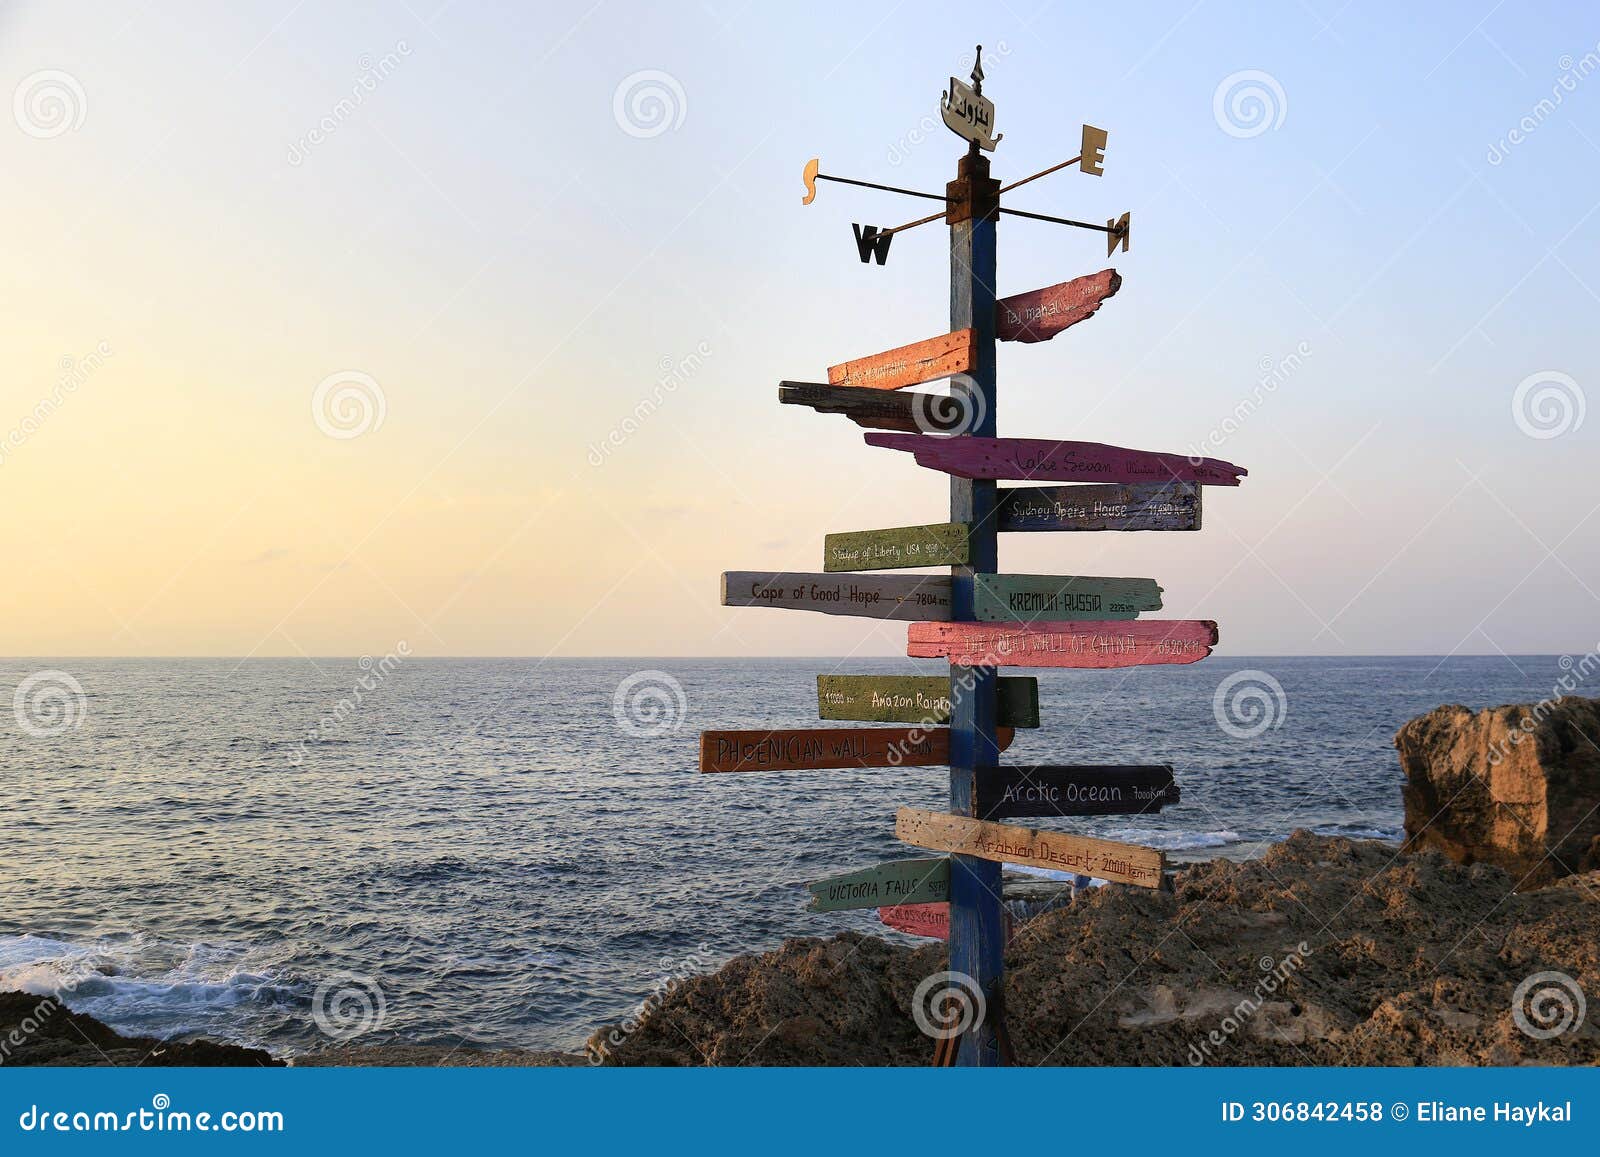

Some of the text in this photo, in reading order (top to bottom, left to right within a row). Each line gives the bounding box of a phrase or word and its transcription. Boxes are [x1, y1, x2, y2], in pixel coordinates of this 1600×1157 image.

[1080, 124, 1108, 176] E
[852, 223, 894, 265] W
[1012, 502, 1050, 523] Sydney
[1054, 502, 1086, 520] Opera
[1094, 502, 1127, 518] House
[832, 546, 859, 560] Statue
[862, 546, 871, 560] of
[874, 544, 901, 561] Liberty
[906, 543, 921, 556] USA
[751, 583, 784, 603] Cape
[793, 585, 806, 600] of
[811, 584, 840, 602] Good
[849, 584, 881, 608] Hope
[915, 593, 937, 606] 7804
[1033, 633, 1066, 652] WALL
[1071, 634, 1087, 652] OF
[1091, 634, 1137, 654] CHINA
[872, 690, 913, 708] Amazon
[717, 736, 824, 764] PHOENICIAN
[1003, 780, 1059, 802] Arctic
[1067, 783, 1122, 801] Ocean
[973, 835, 1035, 859] Arabian
[1039, 841, 1094, 872] Desert
[1101, 857, 1126, 875] 2000
[829, 880, 879, 901] VICTORIA
[886, 878, 918, 895] FALLS
